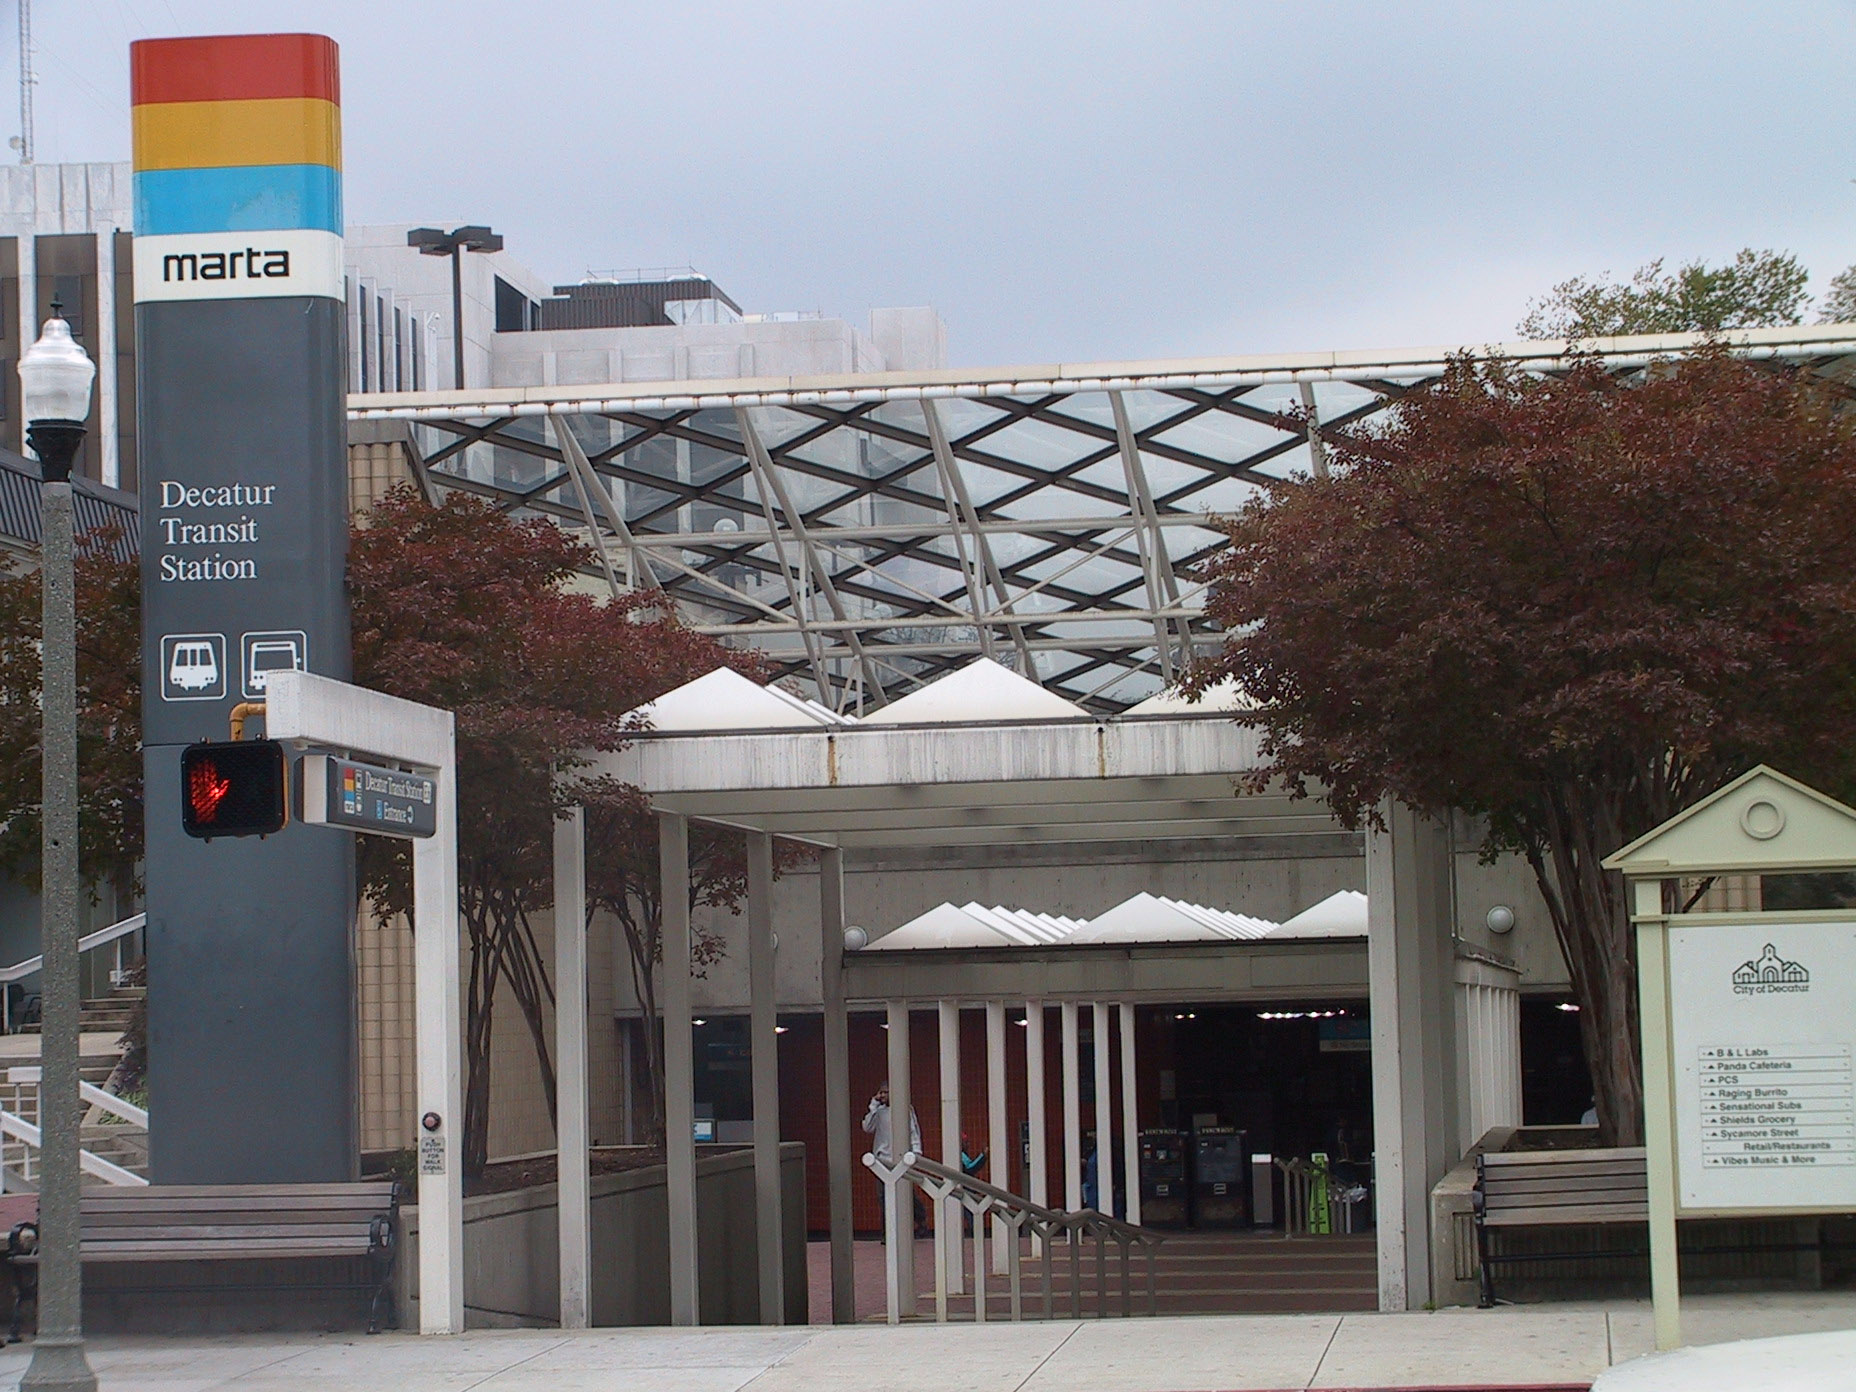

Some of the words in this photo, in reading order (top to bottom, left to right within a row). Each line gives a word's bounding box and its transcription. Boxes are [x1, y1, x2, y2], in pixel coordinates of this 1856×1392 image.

[163, 247, 290, 282] marta
[160, 480, 275, 509] Decatur
[160, 515, 259, 545] Transit
[160, 554, 258, 583] Station
[365, 771, 388, 794] Decatur
[388, 777, 406, 798] Transit
[406, 780, 423, 801] Station
[384, 801, 407, 823] Entrance
[1733, 985, 1755, 996] City
[1756, 985, 1766, 994] of
[1767, 984, 1810, 994] Decatur
[1717, 1048, 1725, 1057] B
[1726, 1049, 1734, 1057] &
[1736, 1048, 1743, 1057] L
[1745, 1048, 1769, 1057] Labs
[1717, 1062, 1747, 1071] Panda
[1749, 1061, 1792, 1070] Cafeteria
[1718, 1075, 1739, 1085] PCS
[1718, 1088, 1752, 1099] Raging
[1754, 1088, 1788, 1097] Burrito
[1720, 1102, 1775, 1111] Sensational
[1777, 1101, 1802, 1110] Subs
[1720, 1115, 1756, 1125] Shields
[1757, 1115, 1796, 1126] Grocery
[1720, 1129, 1768, 1140] Sycamore
[1770, 1128, 1799, 1137] Street
[1721, 1156, 1749, 1165] Vibes
[1750, 1156, 1779, 1164] Music
[1781, 1156, 1789, 1164] &
[1791, 1155, 1816, 1164] More
